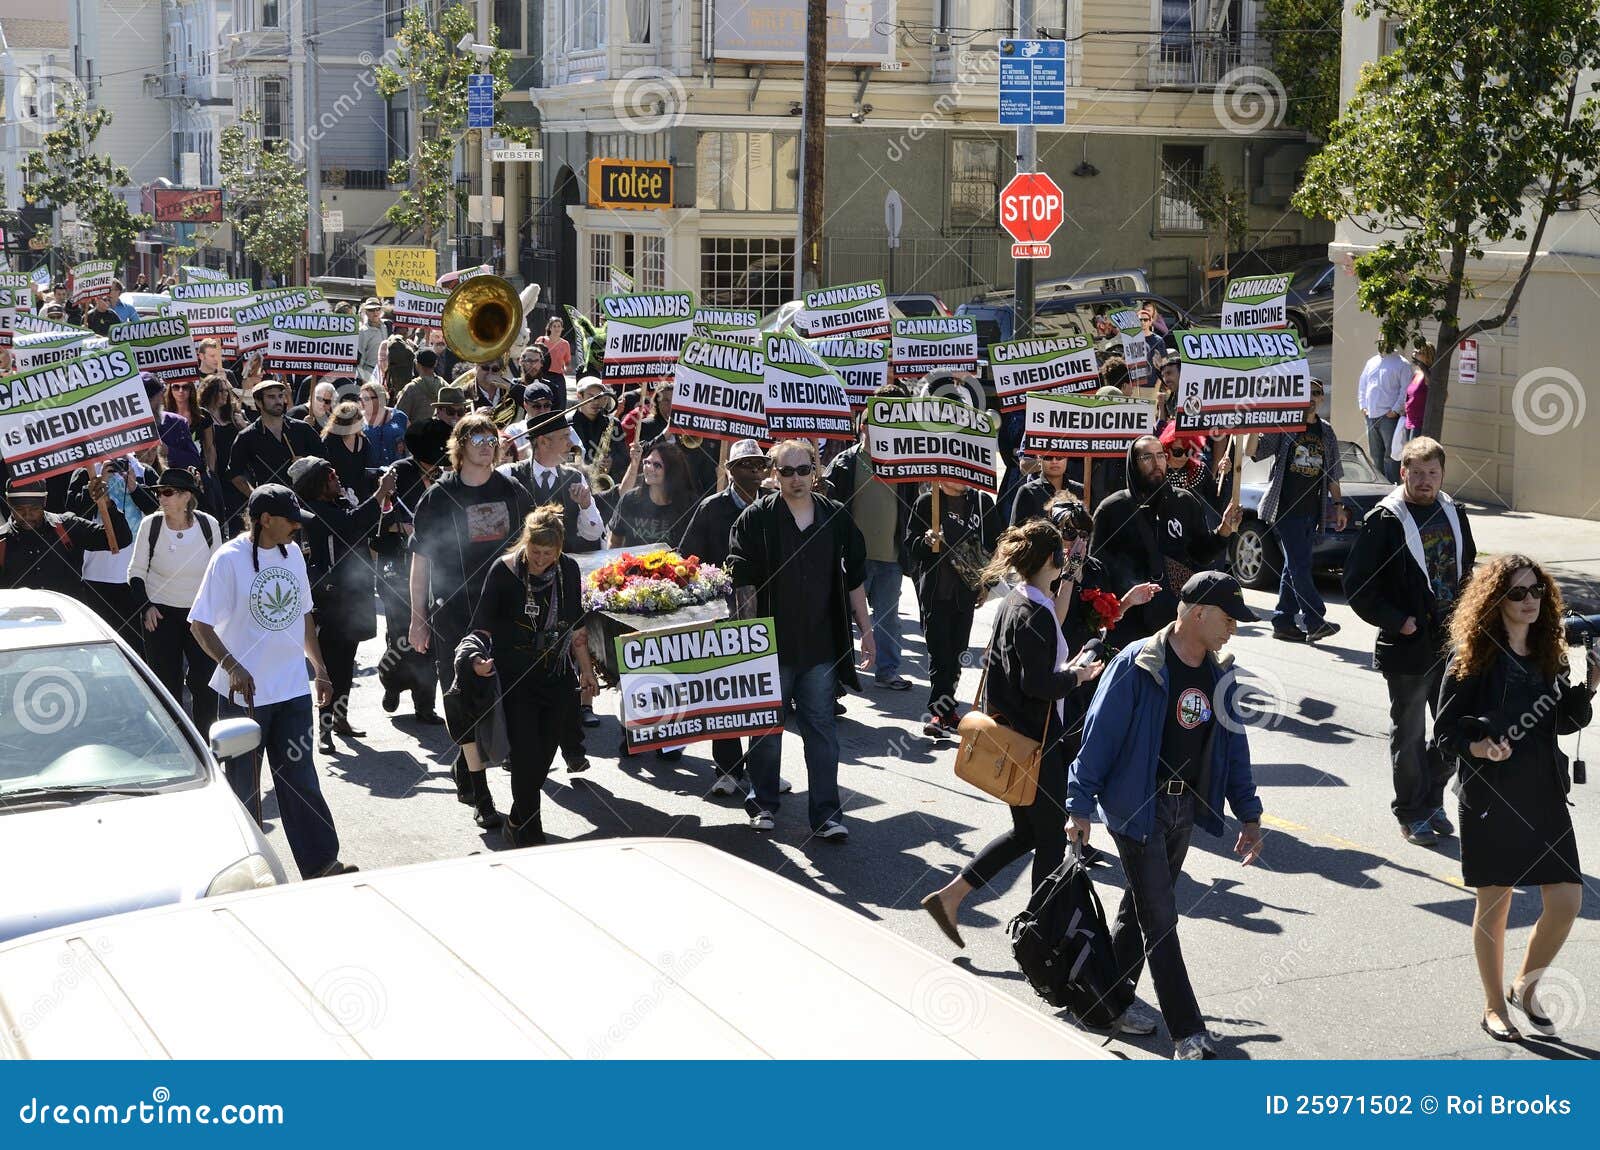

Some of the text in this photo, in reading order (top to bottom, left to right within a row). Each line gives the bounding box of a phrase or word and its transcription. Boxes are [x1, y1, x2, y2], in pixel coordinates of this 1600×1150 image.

[496, 151, 541, 159] WEBSTER
[1004, 195, 1059, 222] STOP
[1015, 246, 1047, 255] ALL WAY
[75, 262, 113, 275] CANNABIS
[381, 268, 432, 278] AN ACTUAL
[386, 260, 426, 269] AFFORD
[174, 281, 249, 299] CANNABIS
[806, 283, 882, 308] CANNABIS
[1228, 276, 1289, 300] CANNABIS
[236, 293, 306, 324] CANNABIS
[604, 294, 690, 318] CANNABIS
[273, 315, 356, 333] CANNABIS
[811, 307, 885, 329] IS MEDICINE
[896, 318, 973, 335] CANNABIS
[1225, 306, 1283, 327] IS MEDICINE
[111, 318, 186, 342] CANNABIS
[242, 334, 250, 343] IS
[852, 326, 889, 338] REGULATE!
[273, 340, 354, 357] IS MEDICINE
[610, 337, 619, 350] IS
[896, 343, 973, 358] IS MEDICINE
[994, 336, 1088, 363] CANNABIS
[1182, 333, 1299, 360] CANNABIS
[20, 358, 30, 367] IS
[135, 345, 193, 366] EDICINE
[270, 360, 354, 373] LET STATES REGULATE!
[605, 365, 619, 376] LET
[620, 363, 645, 376] STATES
[896, 365, 909, 373] LET
[910, 364, 936, 373] STATES
[1000, 358, 1093, 387] IS MEDICINE
[0, 351, 131, 411] CANNABIS
[679, 383, 690, 396] IS
[1185, 374, 1305, 400] IS MEDICINE
[768, 385, 778, 398] IS
[781, 381, 847, 406] MEDICINE
[1002, 395, 1019, 407] LET
[5, 393, 144, 446] IS MEDICINE
[673, 412, 691, 426] LET
[692, 414, 727, 432] STATES
[769, 416, 784, 429] LET
[785, 415, 815, 430] STATES
[874, 399, 990, 434] CANNABIS
[1032, 410, 1148, 430] IS MEDICINE
[1180, 409, 1304, 428] LET STATES REGULATE!
[13, 427, 153, 477] LET STATES REGULATE!
[876, 436, 992, 466] IS MEDICINE
[1029, 437, 1049, 448] LET
[1050, 437, 1089, 450] STATES
[875, 463, 994, 487] LET STATES REGULATE!
[623, 624, 770, 669] CANNABIS
[631, 672, 774, 711] IS MEDICINE
[632, 710, 778, 743] LET STATES REGULATE!
